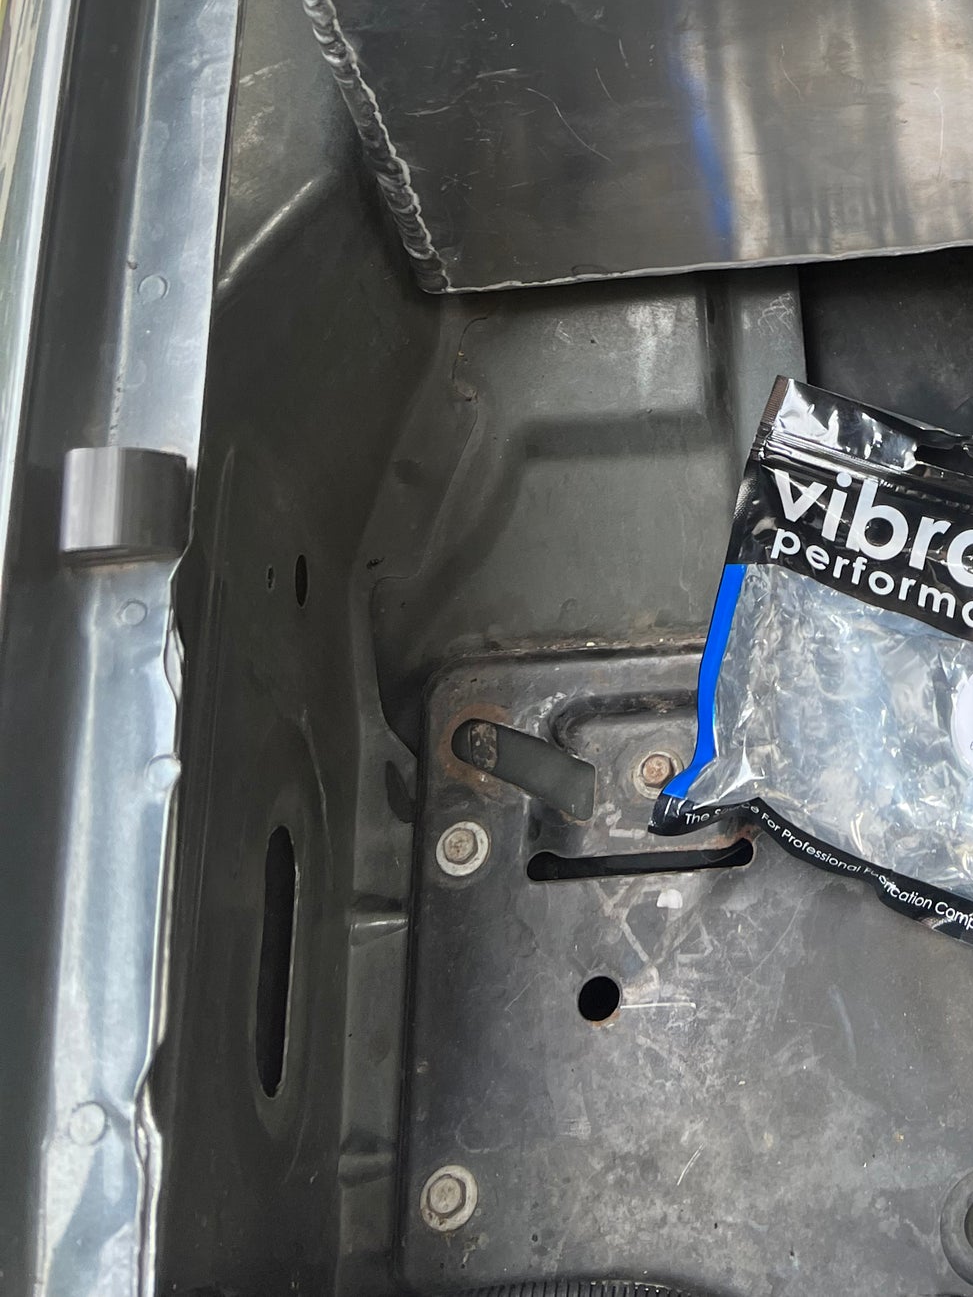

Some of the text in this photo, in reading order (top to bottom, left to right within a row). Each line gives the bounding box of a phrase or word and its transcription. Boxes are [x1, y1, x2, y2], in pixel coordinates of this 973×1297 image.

[685, 812, 710, 825] The
[761, 812, 781, 832] For
[782, 828, 861, 873] Professional
